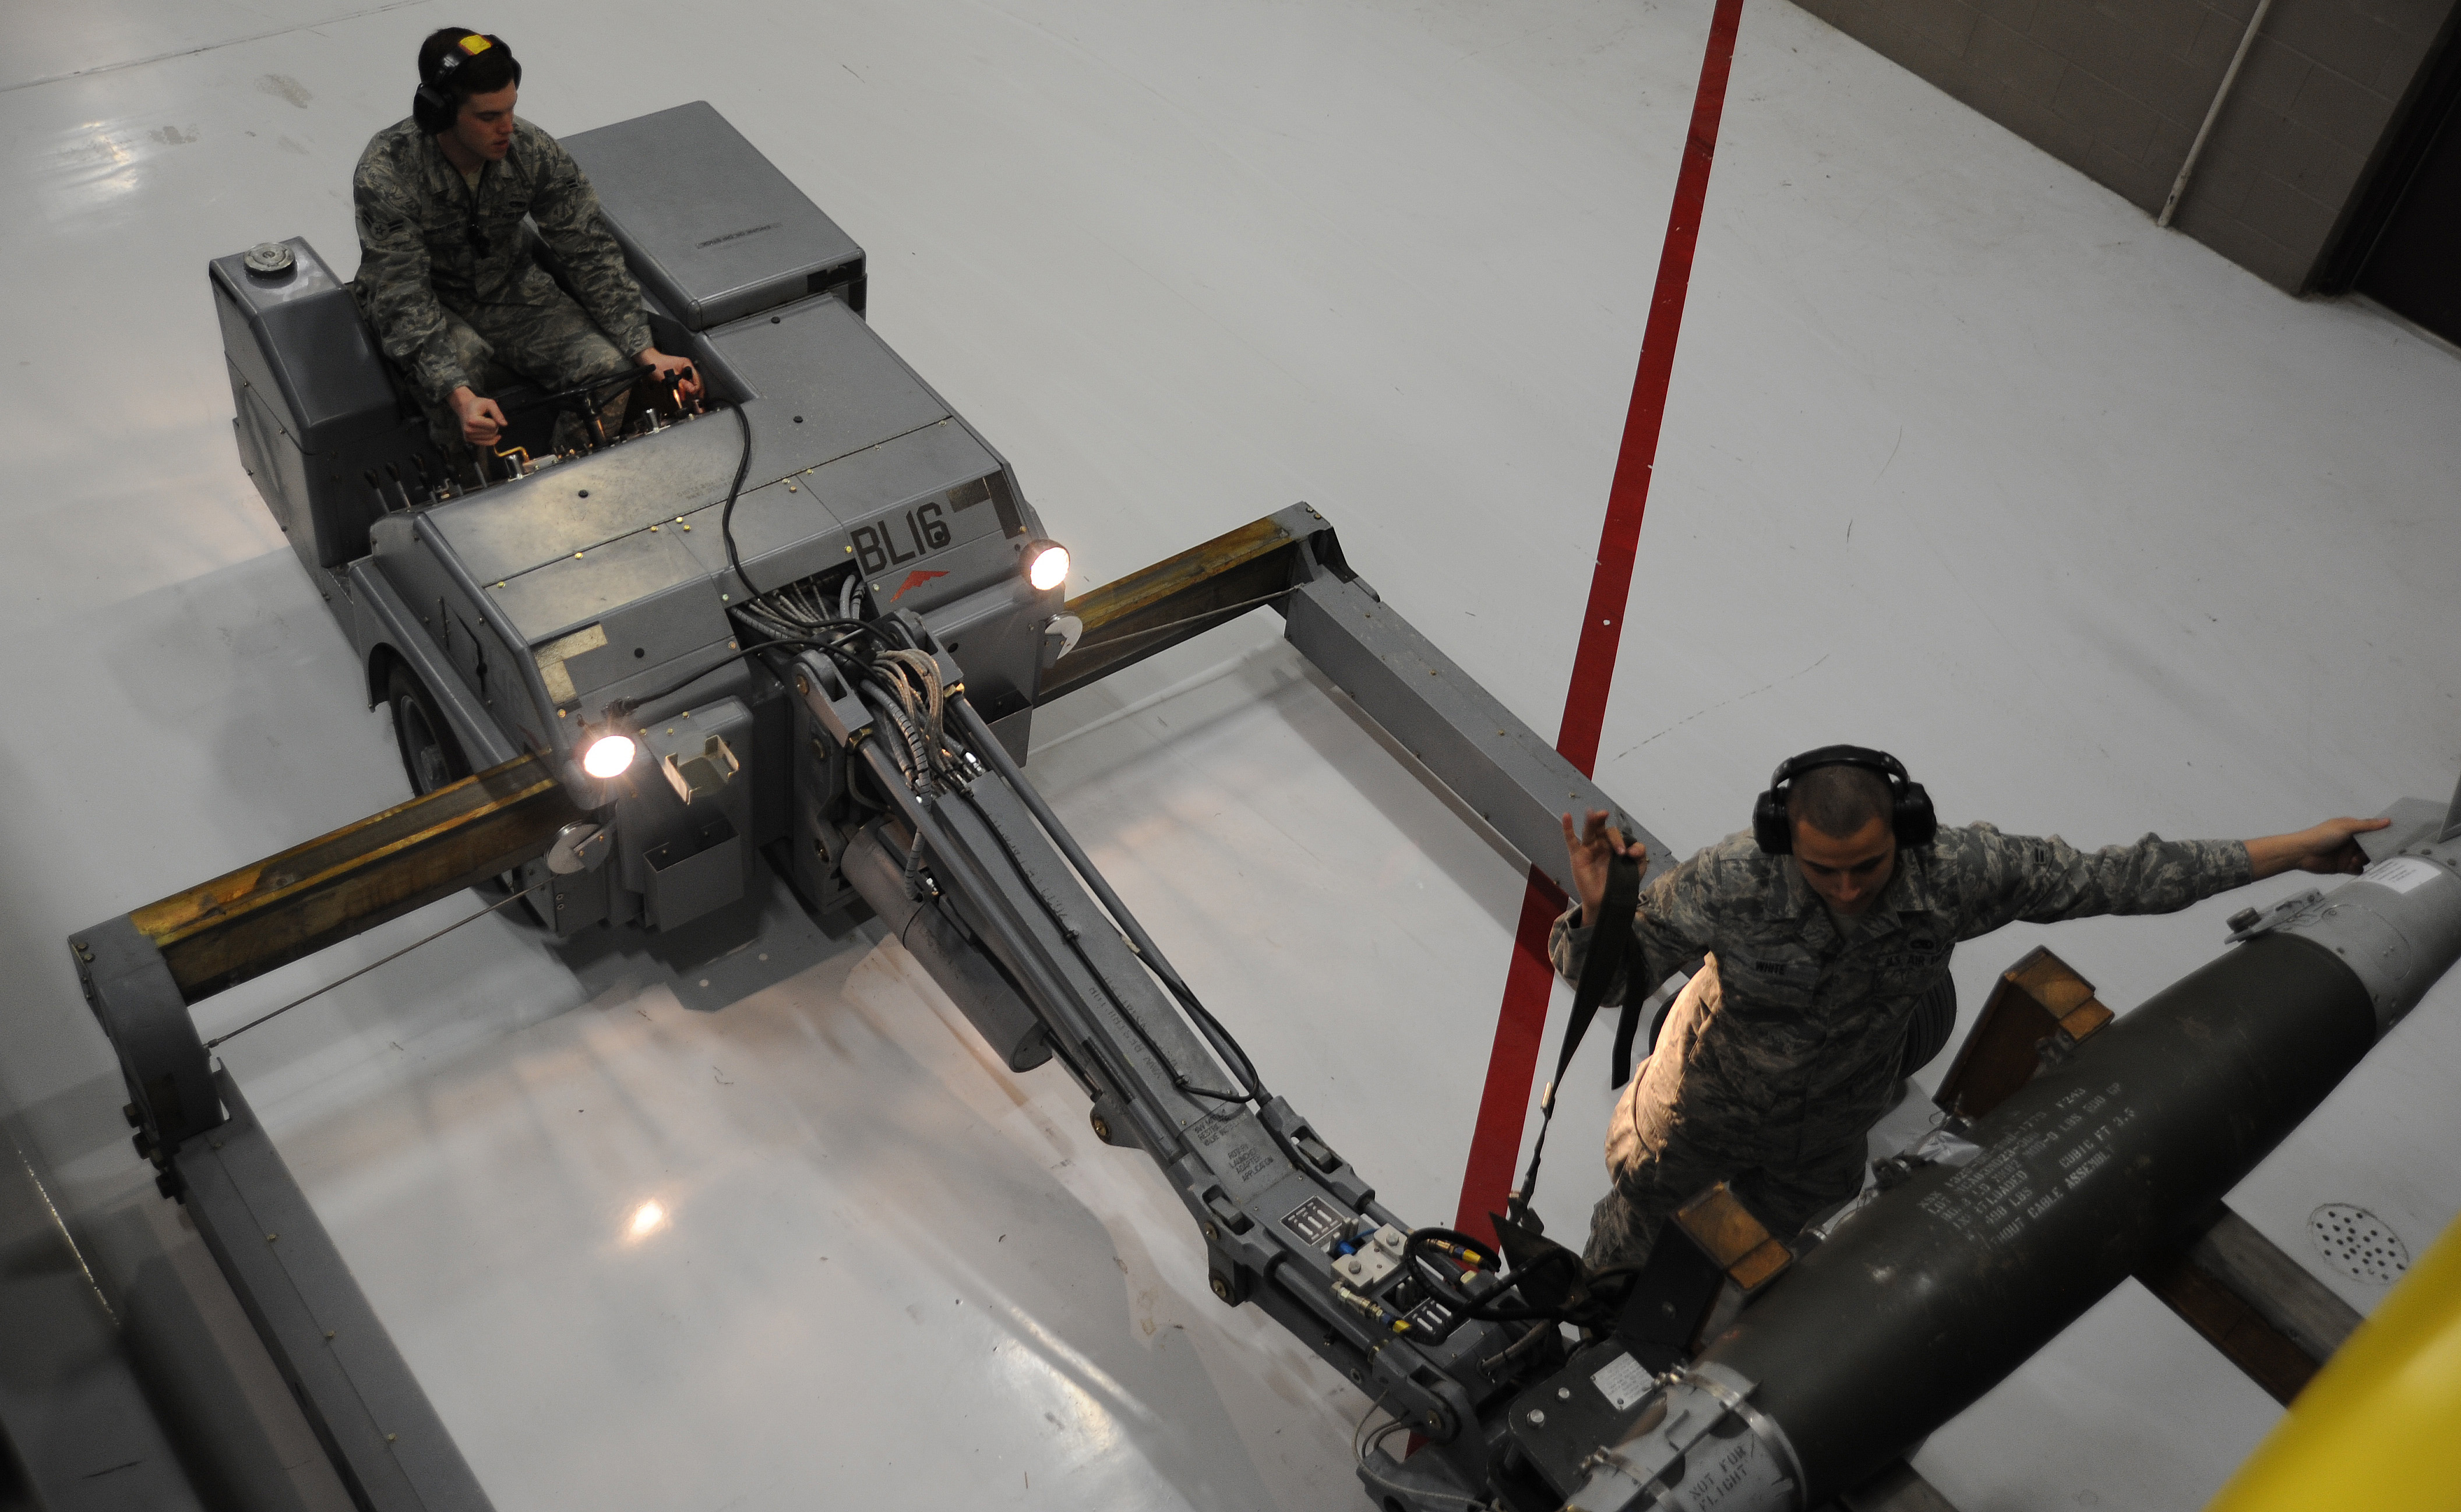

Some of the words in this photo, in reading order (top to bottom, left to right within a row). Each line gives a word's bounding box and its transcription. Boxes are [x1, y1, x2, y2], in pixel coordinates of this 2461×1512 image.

[850, 501, 951, 577] BL16
[1755, 960, 1786, 977] WHITE
[1907, 955, 1924, 967] AIR
[1985, 1170, 2028, 1205] LOADED
[2008, 1186, 2033, 1206] LBS
[2059, 1139, 2094, 1168] CUBIC
[2095, 1125, 2110, 1140] FT
[2028, 1186, 2063, 1219] CABLE
[2065, 1144, 2114, 1189] ASSEMBLY
[1689, 1472, 1713, 1500] NOT
[1719, 1446, 1746, 1472] FOR
[1700, 1464, 1747, 1512] FLIGHT
